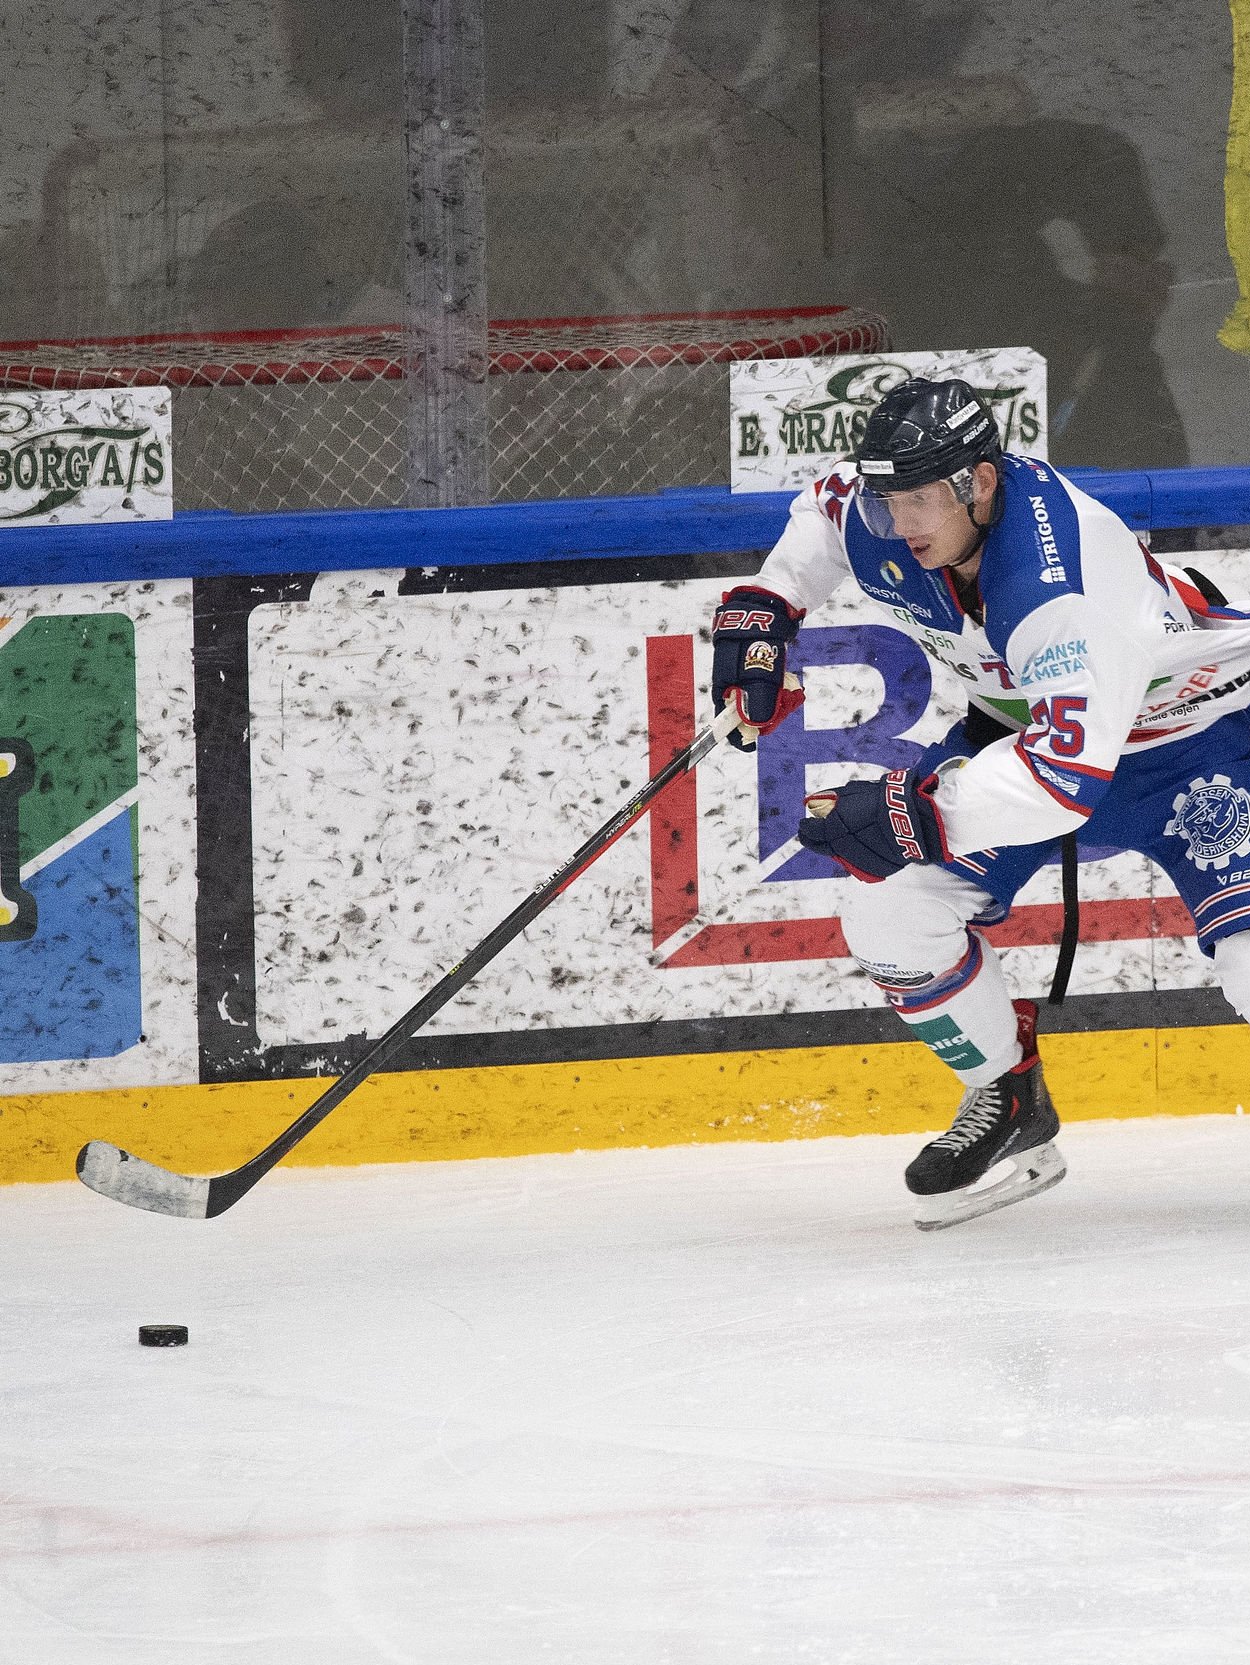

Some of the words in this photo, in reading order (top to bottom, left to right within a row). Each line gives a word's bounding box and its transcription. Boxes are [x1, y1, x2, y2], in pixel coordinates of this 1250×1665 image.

[737, 414, 770, 457] E.
[962, 418, 990, 445] BAUER
[0, 444, 91, 491] BORG
[102, 440, 165, 493] A/S
[1030, 495, 1061, 565] TRIGON
[1170, 703, 1200, 717] vejen
